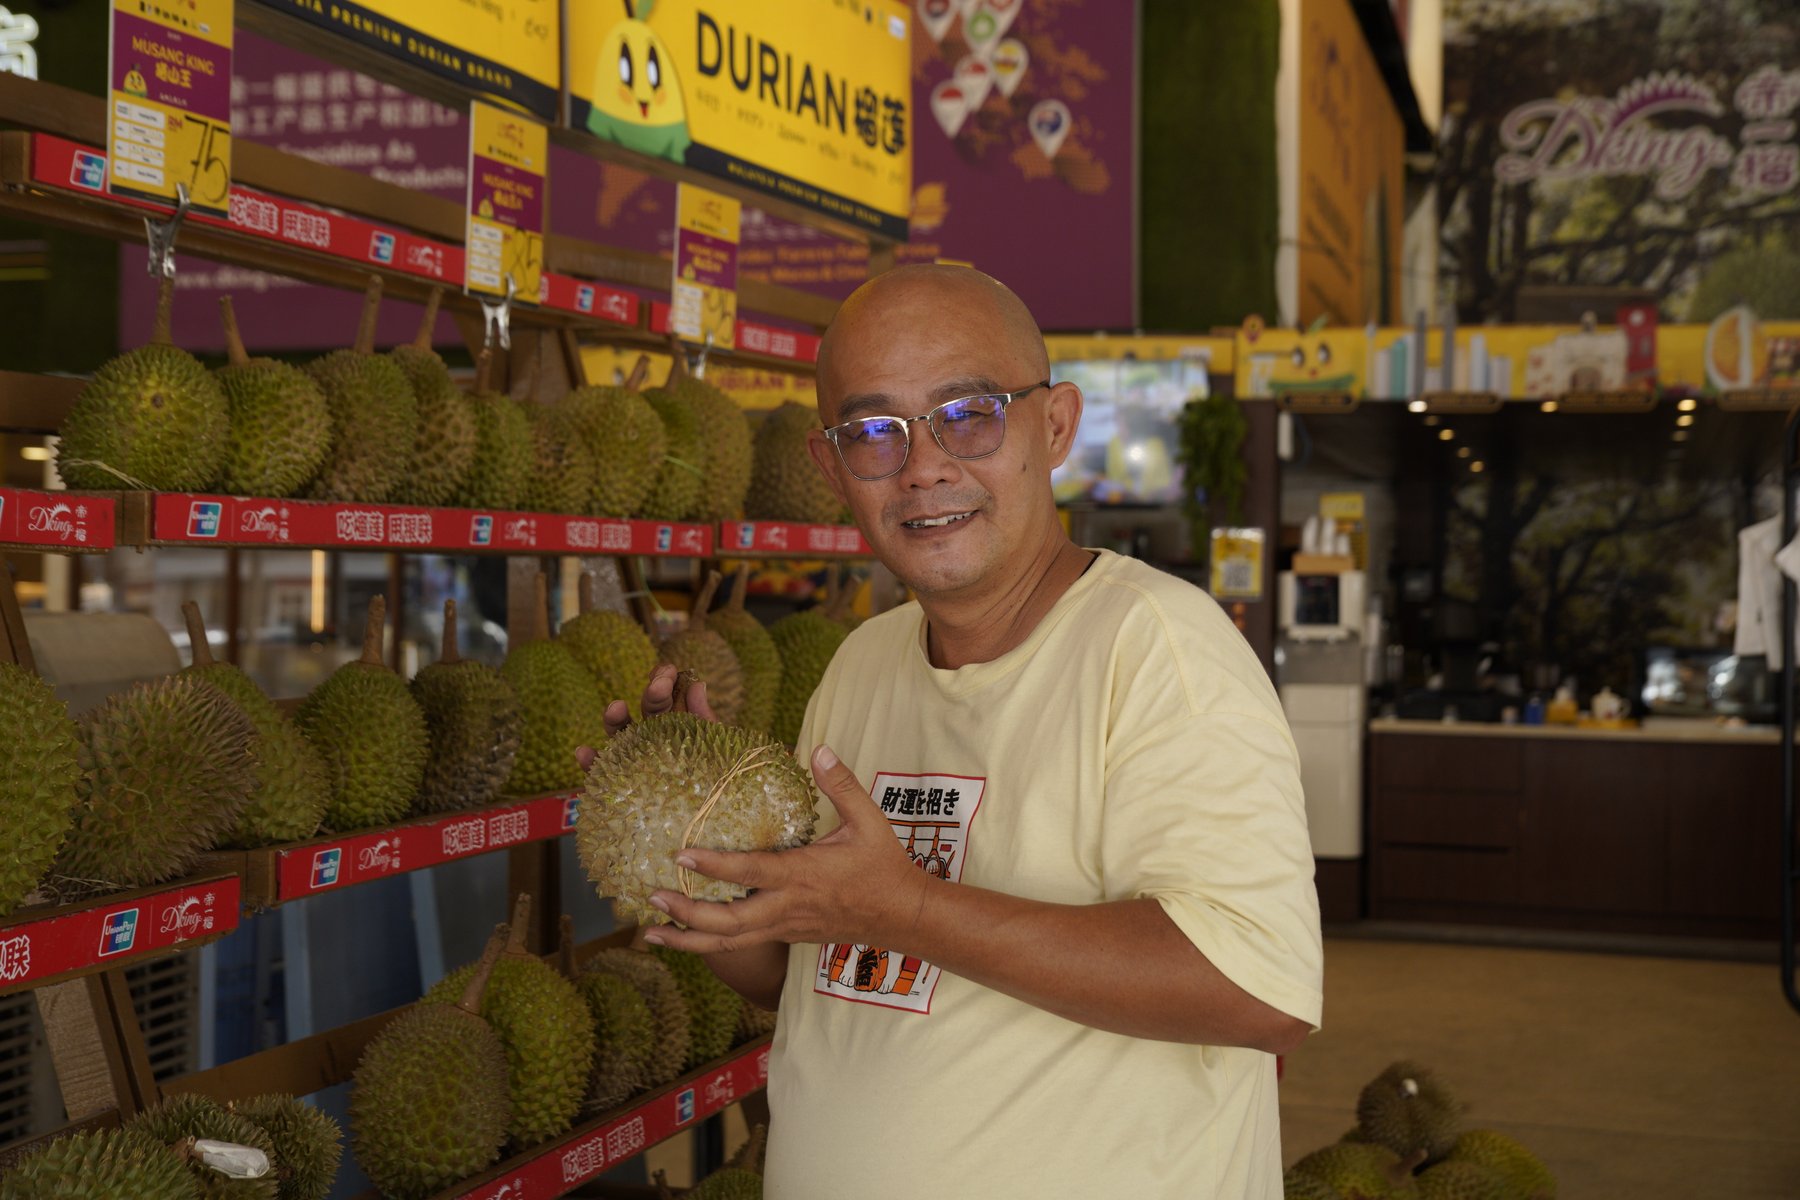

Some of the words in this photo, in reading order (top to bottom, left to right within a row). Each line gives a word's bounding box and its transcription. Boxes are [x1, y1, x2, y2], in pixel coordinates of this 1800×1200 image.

[131, 35, 185, 67] MUSANG
[185, 53, 215, 77] KING
[696, 10, 848, 135] DURIAN
[183, 113, 231, 204] 75
[880, 786, 960, 817] 財運を招き
[104, 921, 135, 936] UnionPay
